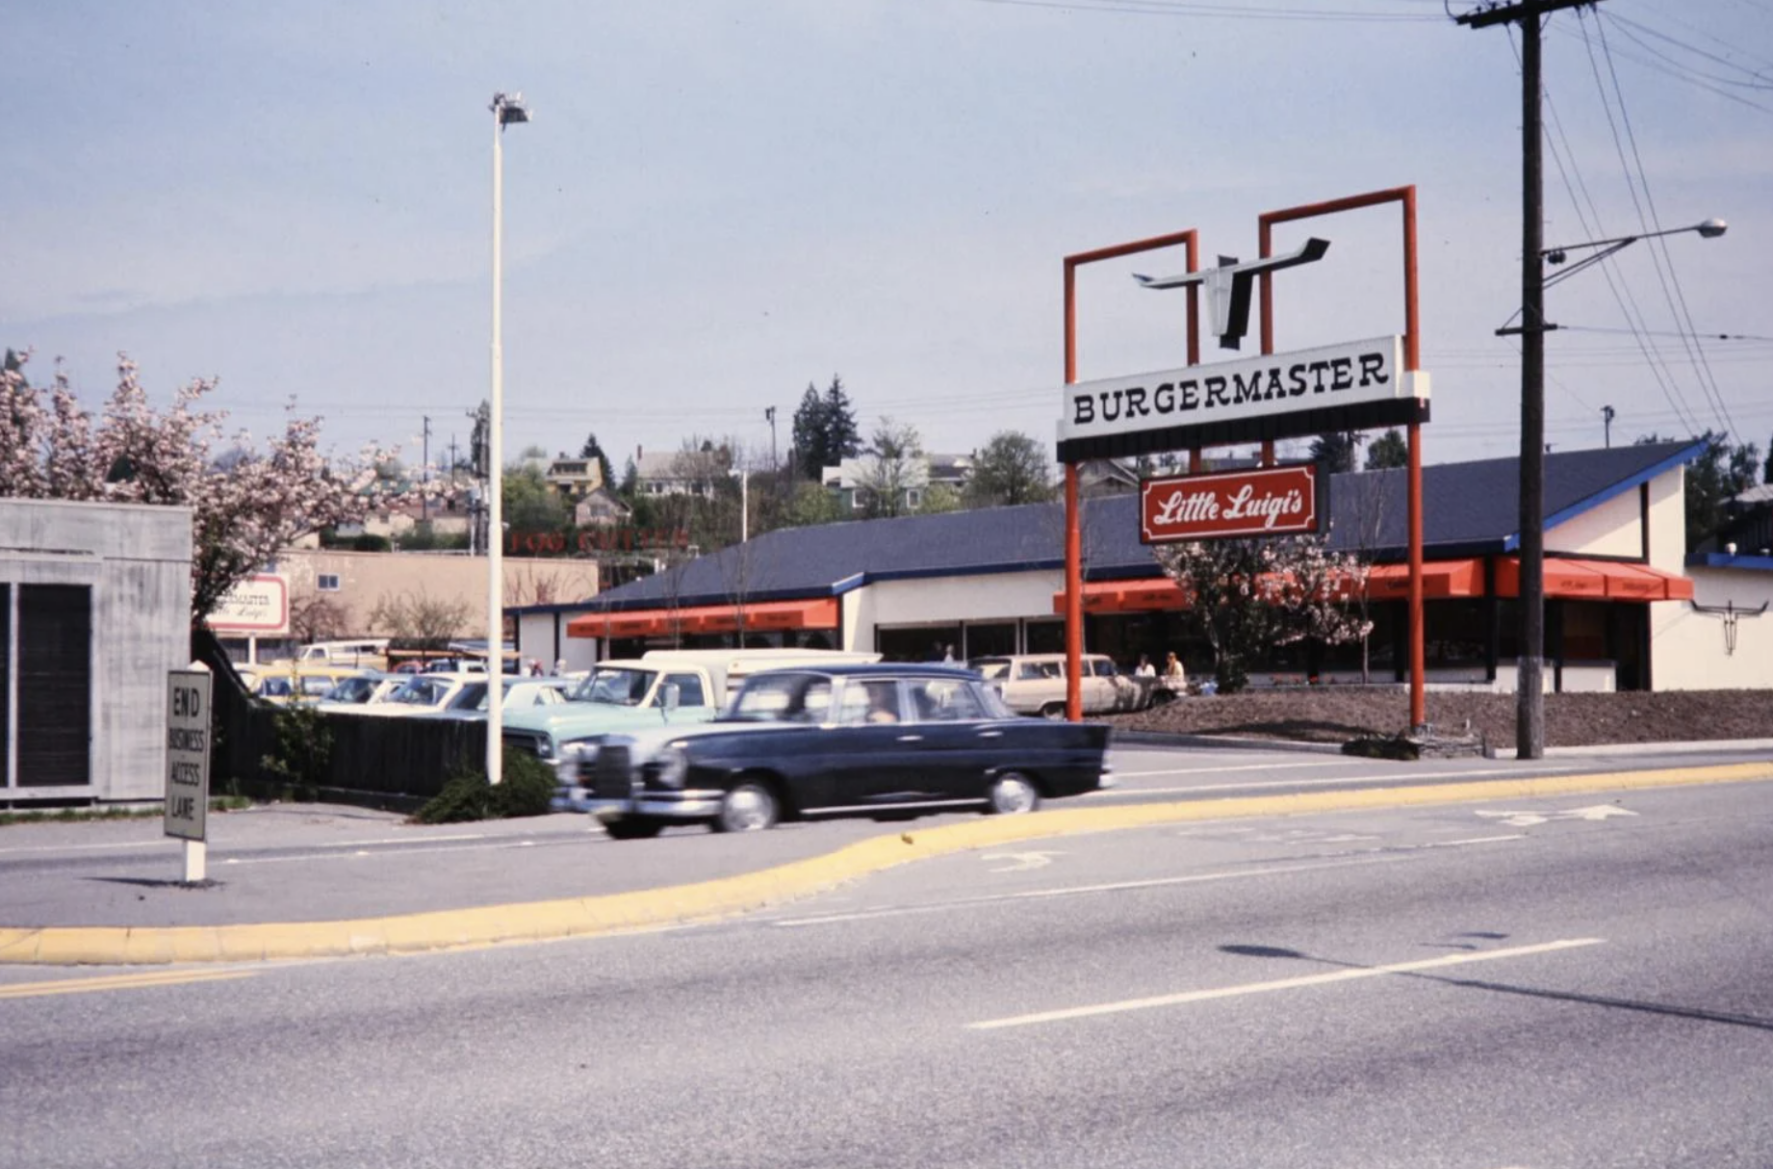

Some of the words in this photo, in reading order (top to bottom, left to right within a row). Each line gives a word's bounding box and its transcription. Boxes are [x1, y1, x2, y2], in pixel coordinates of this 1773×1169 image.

[1073, 352, 1389, 425] BURGERMASTER
[1153, 490, 1220, 526] Little
[1222, 484, 1302, 530] Luigi's
[173, 687, 200, 718] END
[169, 727, 204, 752] BUSINESS
[171, 761, 200, 787] ACCESS
[171, 795, 195, 821] LANE
